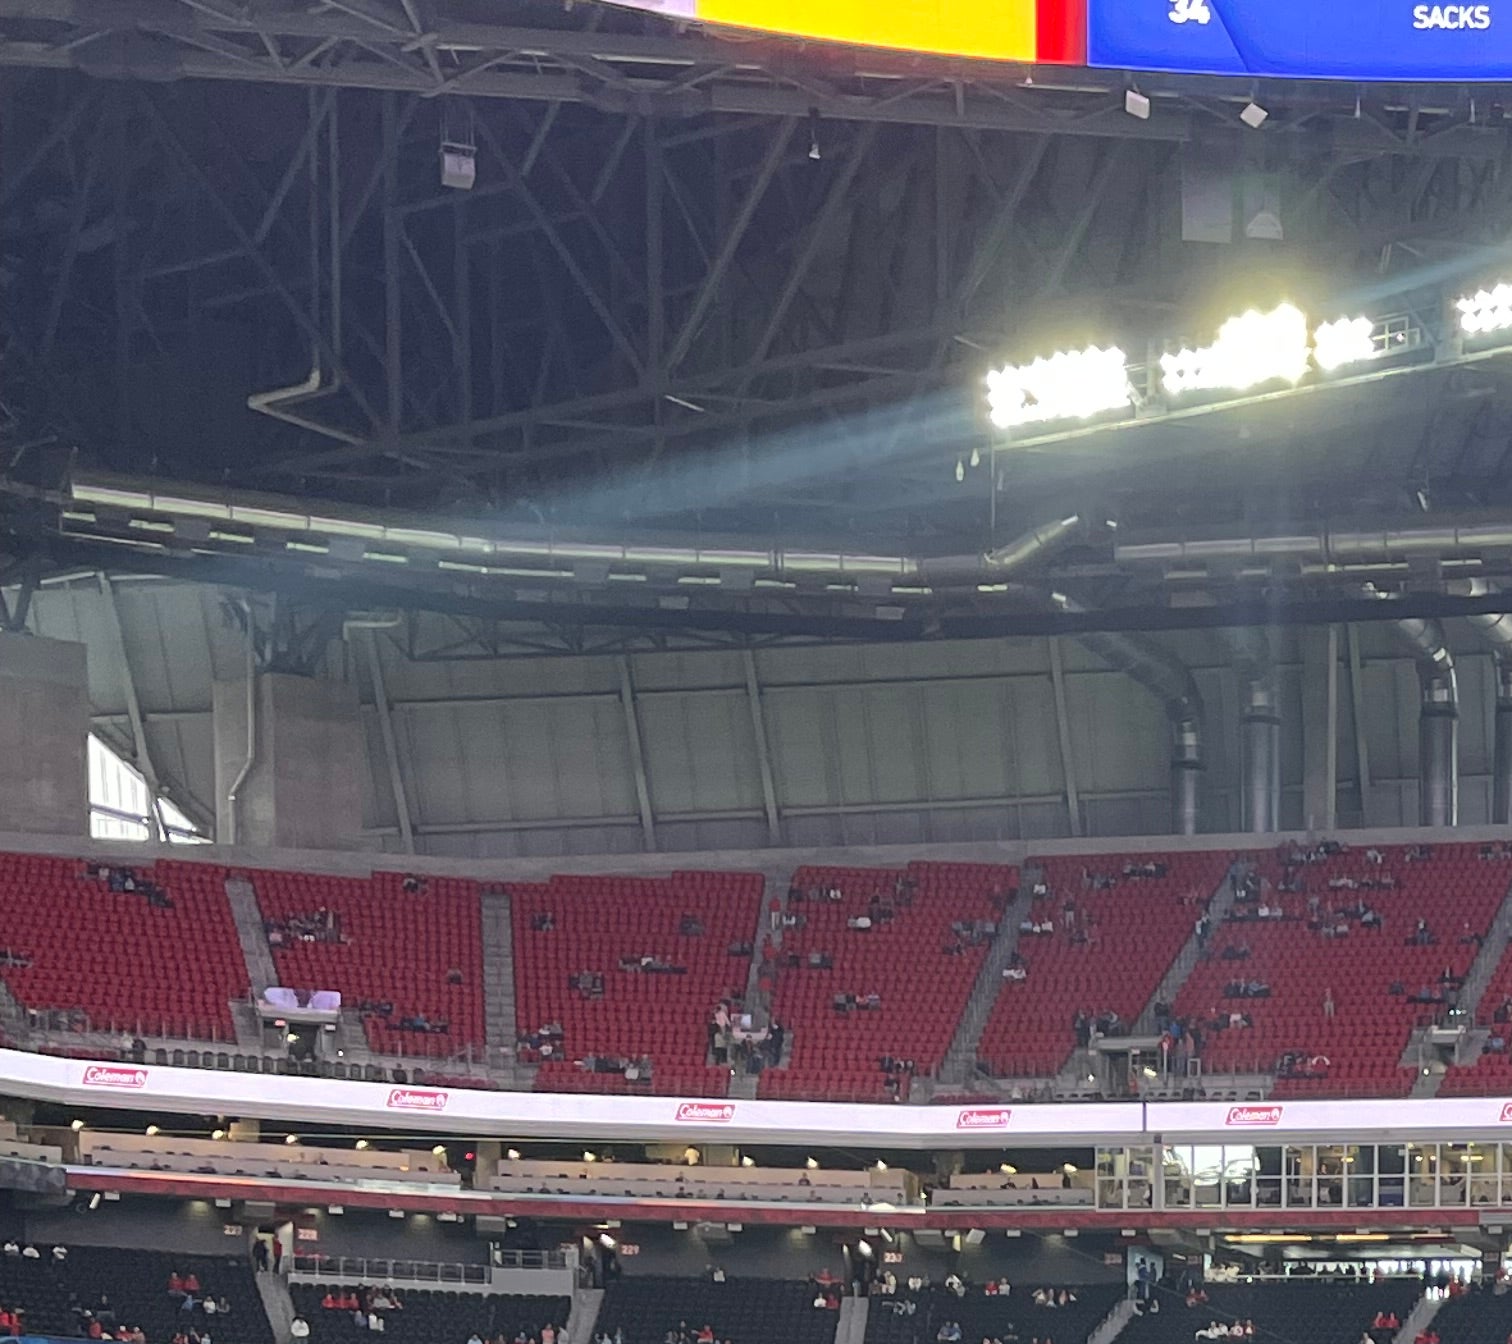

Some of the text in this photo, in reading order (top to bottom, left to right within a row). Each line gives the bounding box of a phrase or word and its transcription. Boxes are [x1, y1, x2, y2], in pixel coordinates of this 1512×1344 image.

[1413, 5, 1490, 29] SACKS
[86, 1067, 134, 1083] Coleman
[391, 1091, 436, 1105] Coleman
[679, 1104, 723, 1118] Coleman
[959, 1111, 1001, 1124] Coleman
[1229, 1107, 1272, 1121] Coleman
